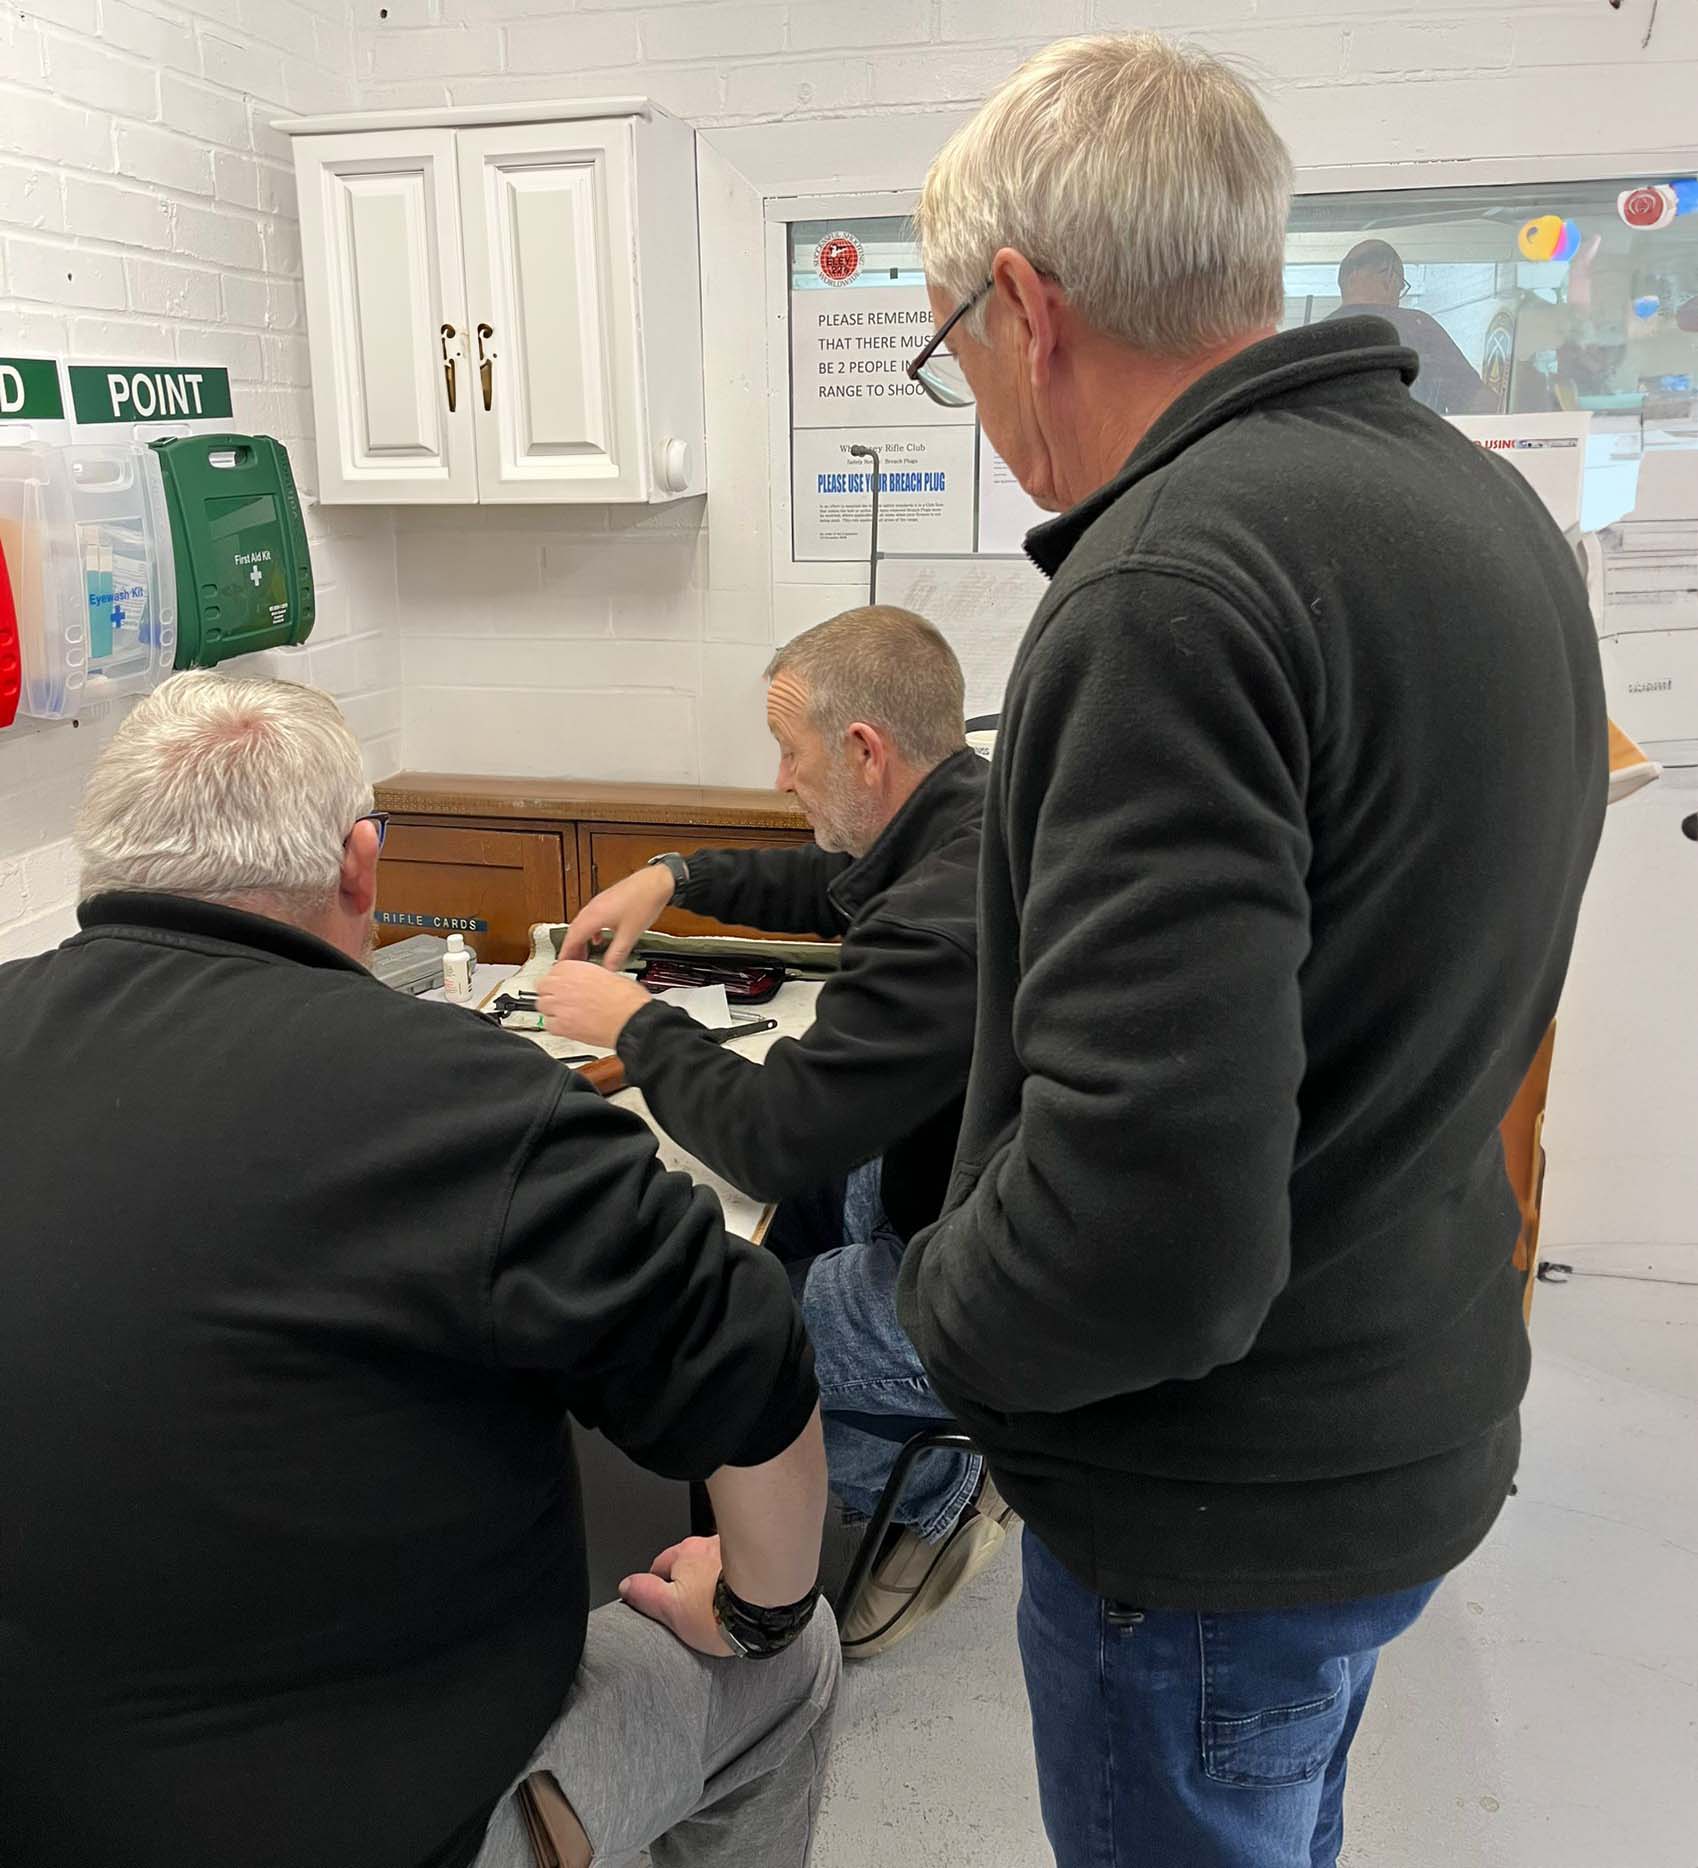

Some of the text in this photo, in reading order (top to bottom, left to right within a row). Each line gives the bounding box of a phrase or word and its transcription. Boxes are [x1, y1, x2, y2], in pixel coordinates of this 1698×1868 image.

[818, 311, 935, 326] PLEASE REMEMBE
[818, 338, 852, 350] THAT
[855, 336, 897, 349] THERE
[819, 362, 834, 374] BE
[838, 362, 845, 373] 2
[849, 360, 897, 373] PEOPLE
[106, 373, 204, 417] POINT
[819, 384, 926, 398] RANGE TO SHOO
[885, 444, 904, 453] Rifle
[906, 443, 926, 452] Club
[818, 473, 846, 493] PLEASE
[848, 473, 864, 493] USE
[889, 472, 922, 492] BREACH
[924, 472, 945, 491] PLUG
[234, 550, 271, 566] First Aid Kit
[89, 586, 144, 607] Eyewash Kit
[383, 912, 477, 931] RIFLE CARDS
